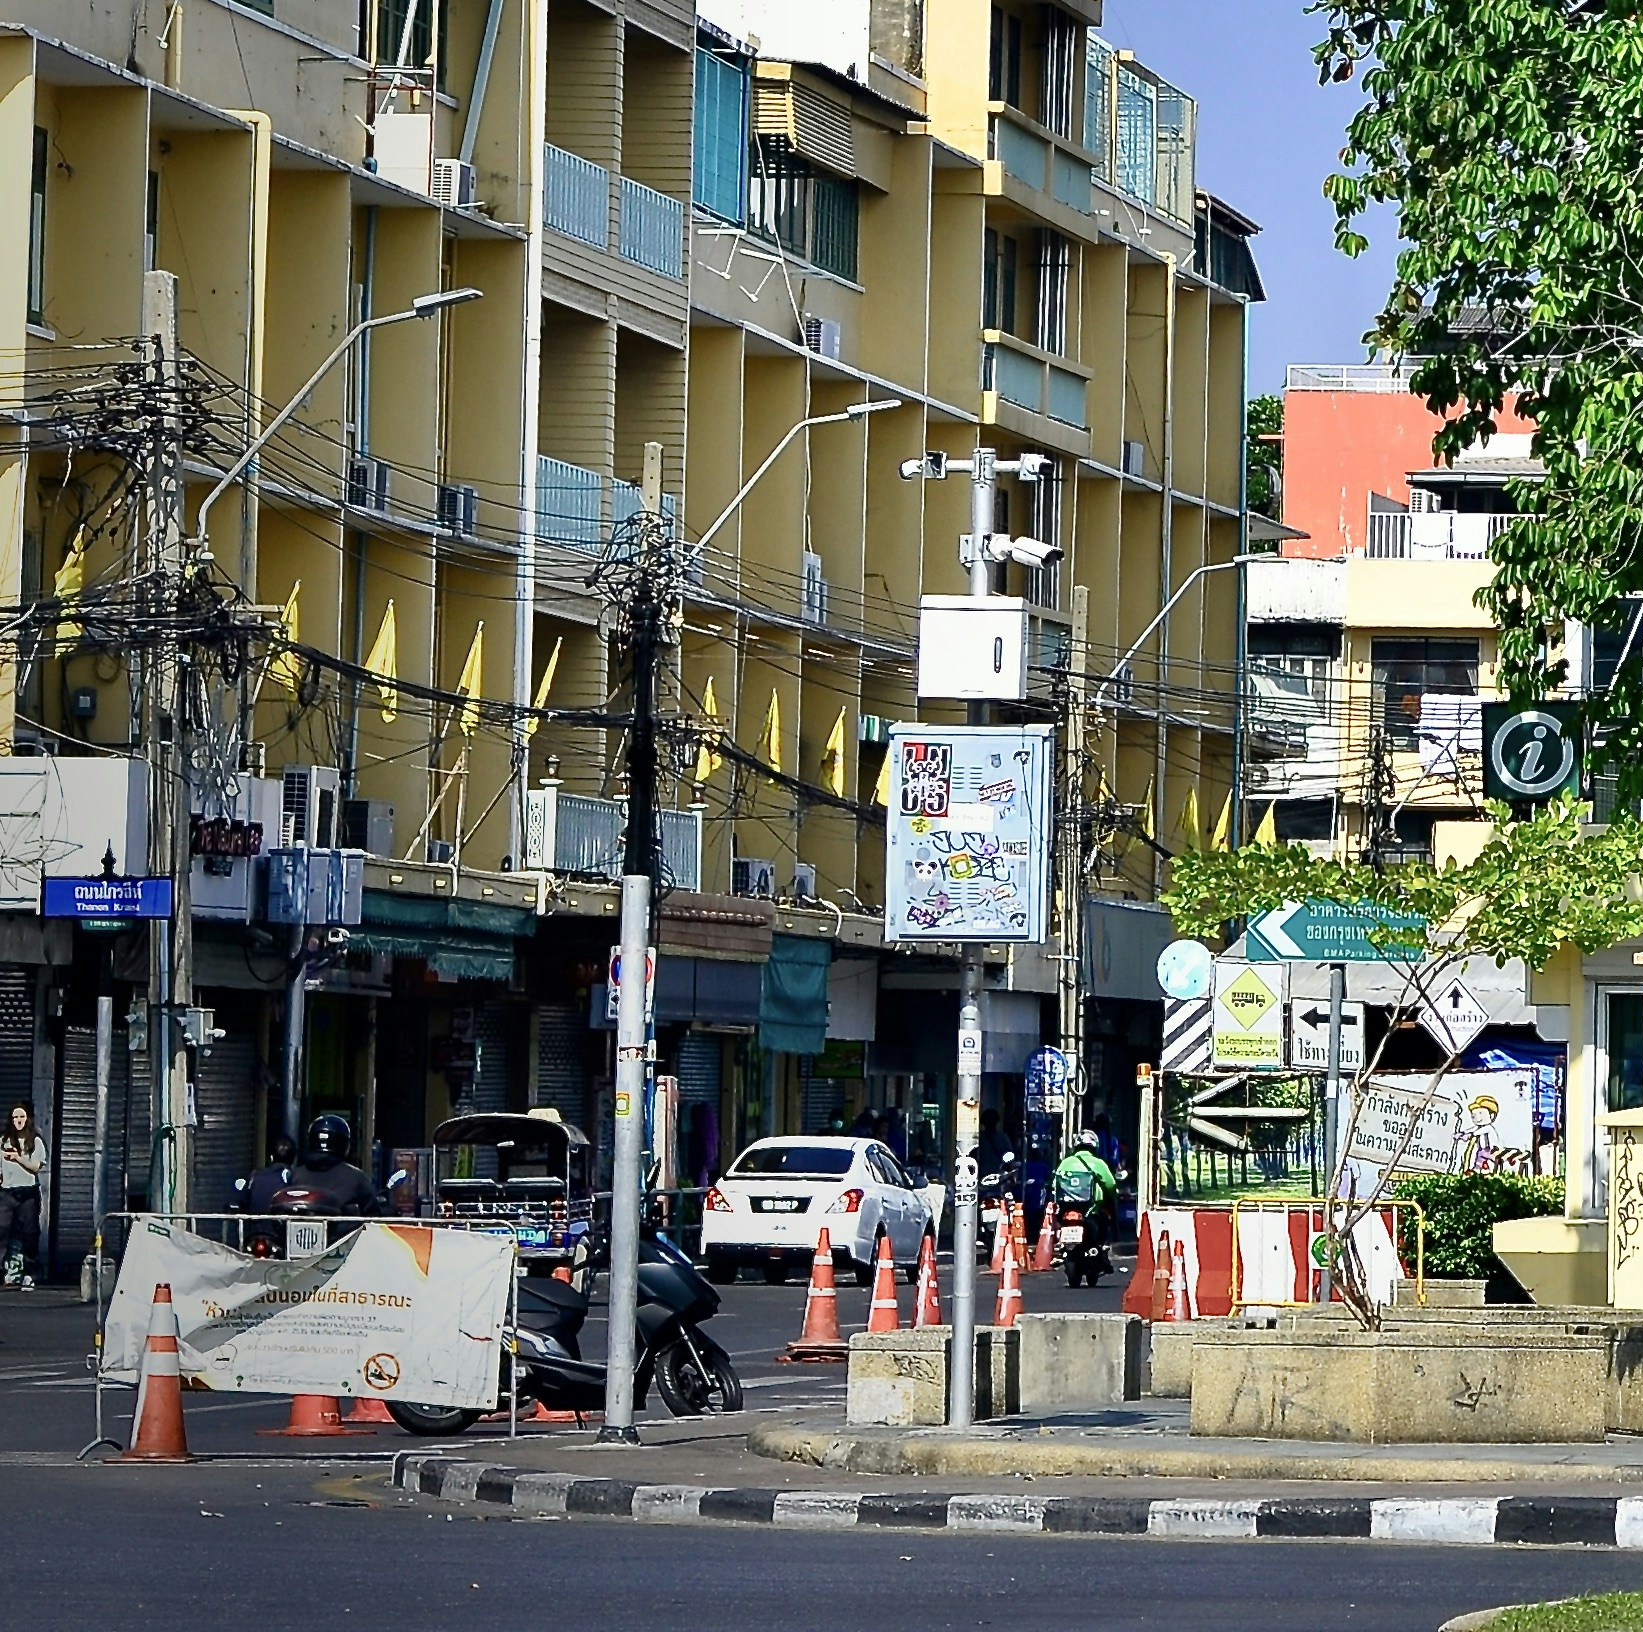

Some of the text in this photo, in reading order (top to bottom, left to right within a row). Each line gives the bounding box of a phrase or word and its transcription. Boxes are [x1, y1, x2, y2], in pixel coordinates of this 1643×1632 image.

[1429, 1010, 1483, 1023] งก่อสร้าง
[1298, 1034, 1360, 1064] ใช้ทาบี่ยง
[1367, 1092, 1448, 1127] กำลังก่สร้าง
